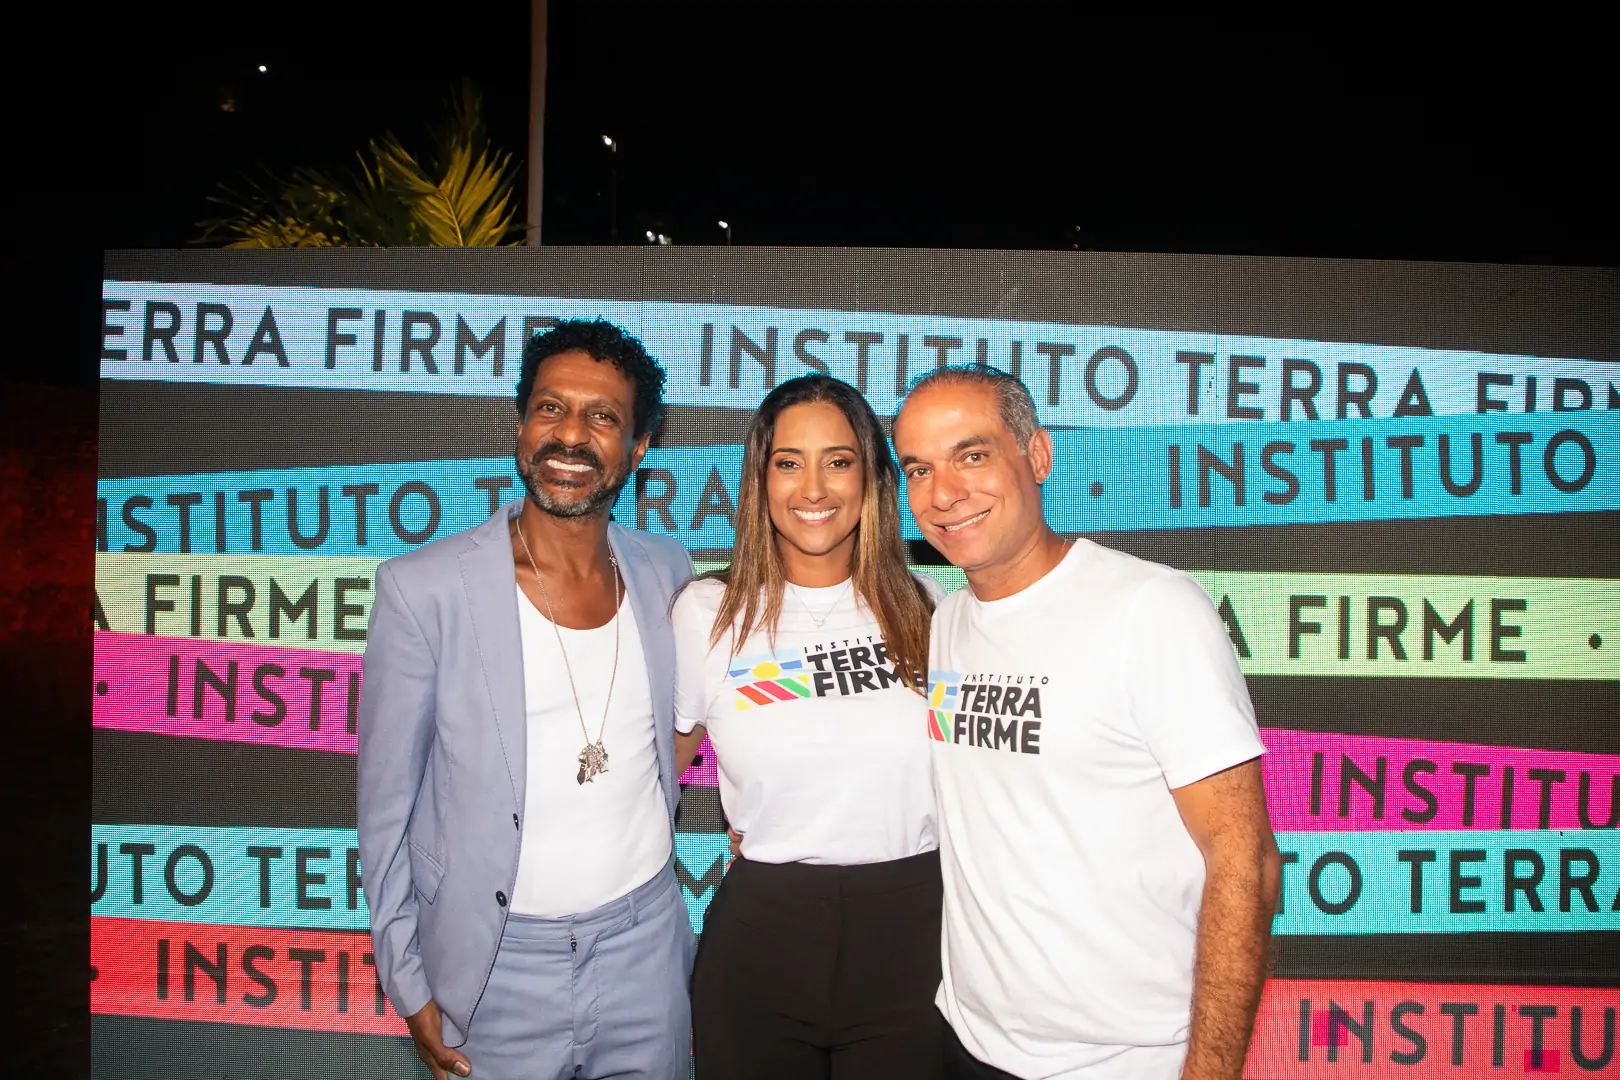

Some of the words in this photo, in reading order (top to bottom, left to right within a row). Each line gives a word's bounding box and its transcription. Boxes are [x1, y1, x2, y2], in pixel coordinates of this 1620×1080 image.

[1176, 351, 1433, 422] TERRA
[1477, 371, 1620, 414] FIR
[1168, 430, 1597, 509] INSTITUTO
[146, 573, 370, 640] FIRME
[1288, 594, 1528, 662] FIRME
[960, 684, 1042, 718] TERRA
[964, 674, 1049, 685] INSTITUTO
[954, 713, 1042, 754] FIRME
[1398, 849, 1620, 914] TERR
[1297, 999, 1616, 1071] INSTITU
